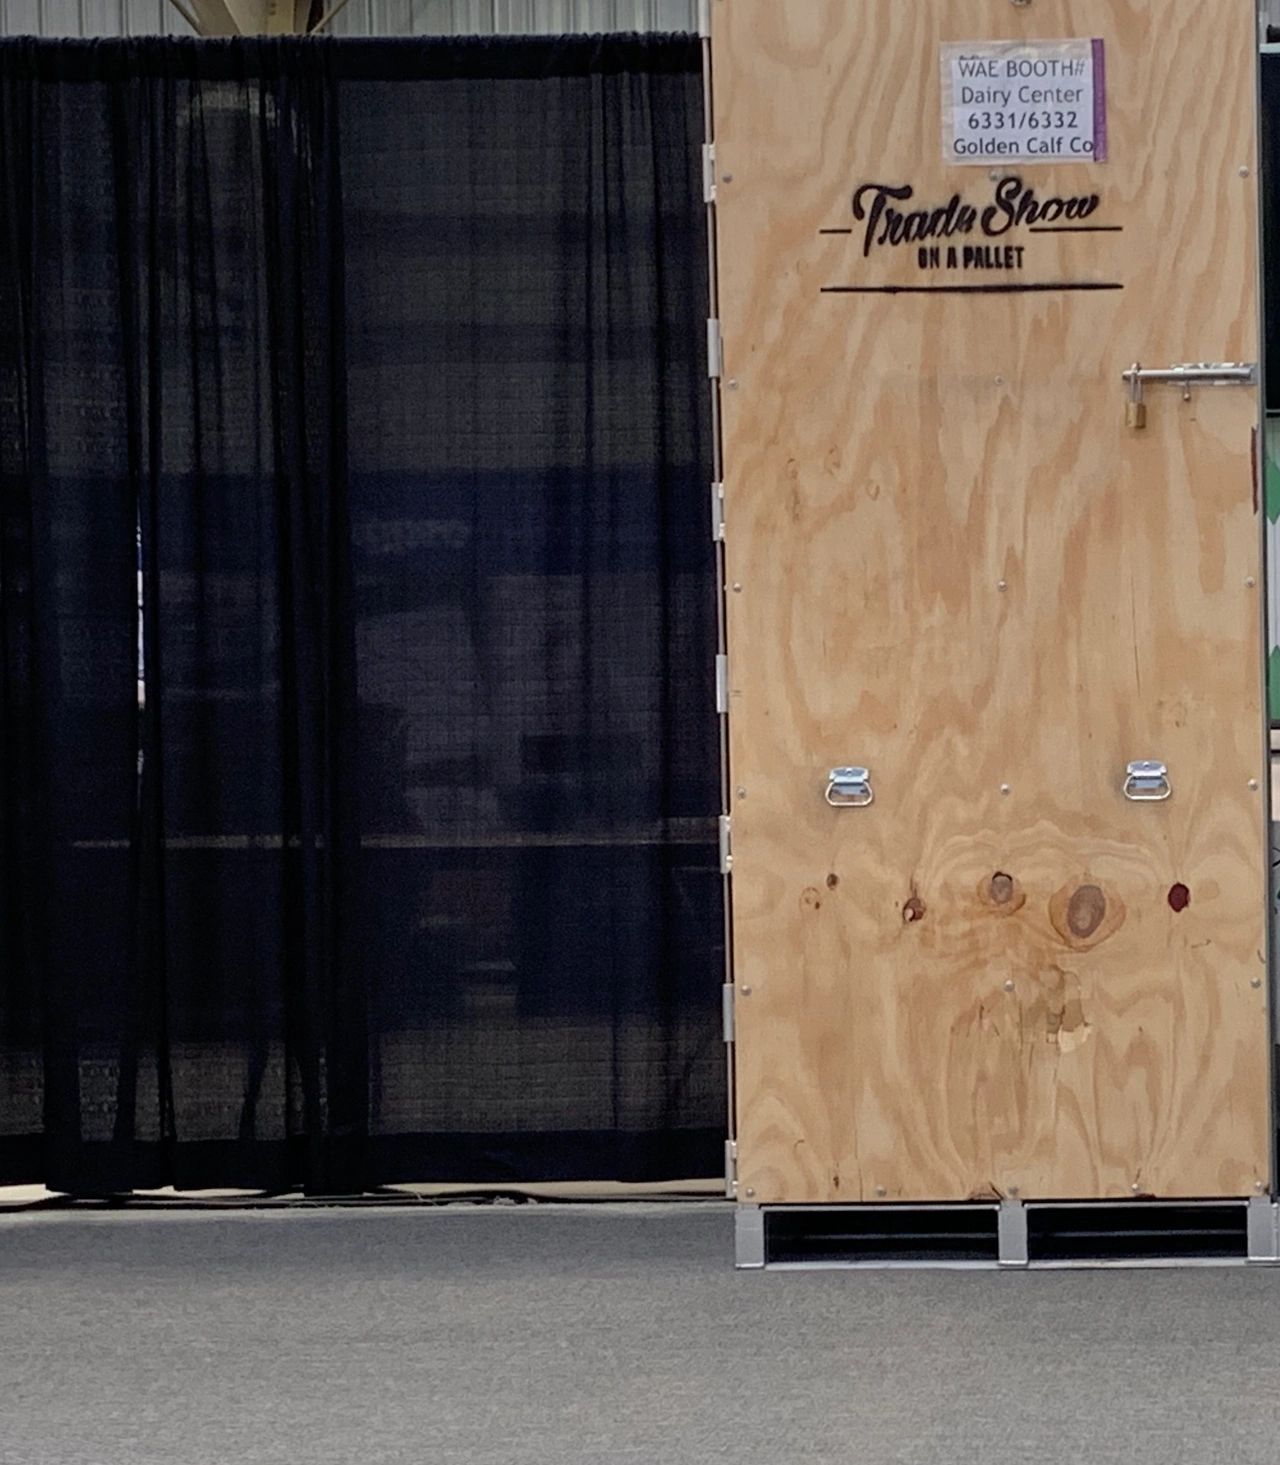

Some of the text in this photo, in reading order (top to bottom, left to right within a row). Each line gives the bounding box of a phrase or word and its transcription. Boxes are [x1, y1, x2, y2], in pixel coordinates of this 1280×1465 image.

[958, 59, 1085, 78] WAE BOOTH#
[961, 85, 1084, 107] Dairy Center
[968, 111, 1078, 129] 6331/6332
[954, 137, 1019, 154] Golden
[1027, 136, 1063, 153] Calf
[852, 176, 1100, 257] Trade Show
[918, 246, 1025, 269] ON A PALLET
